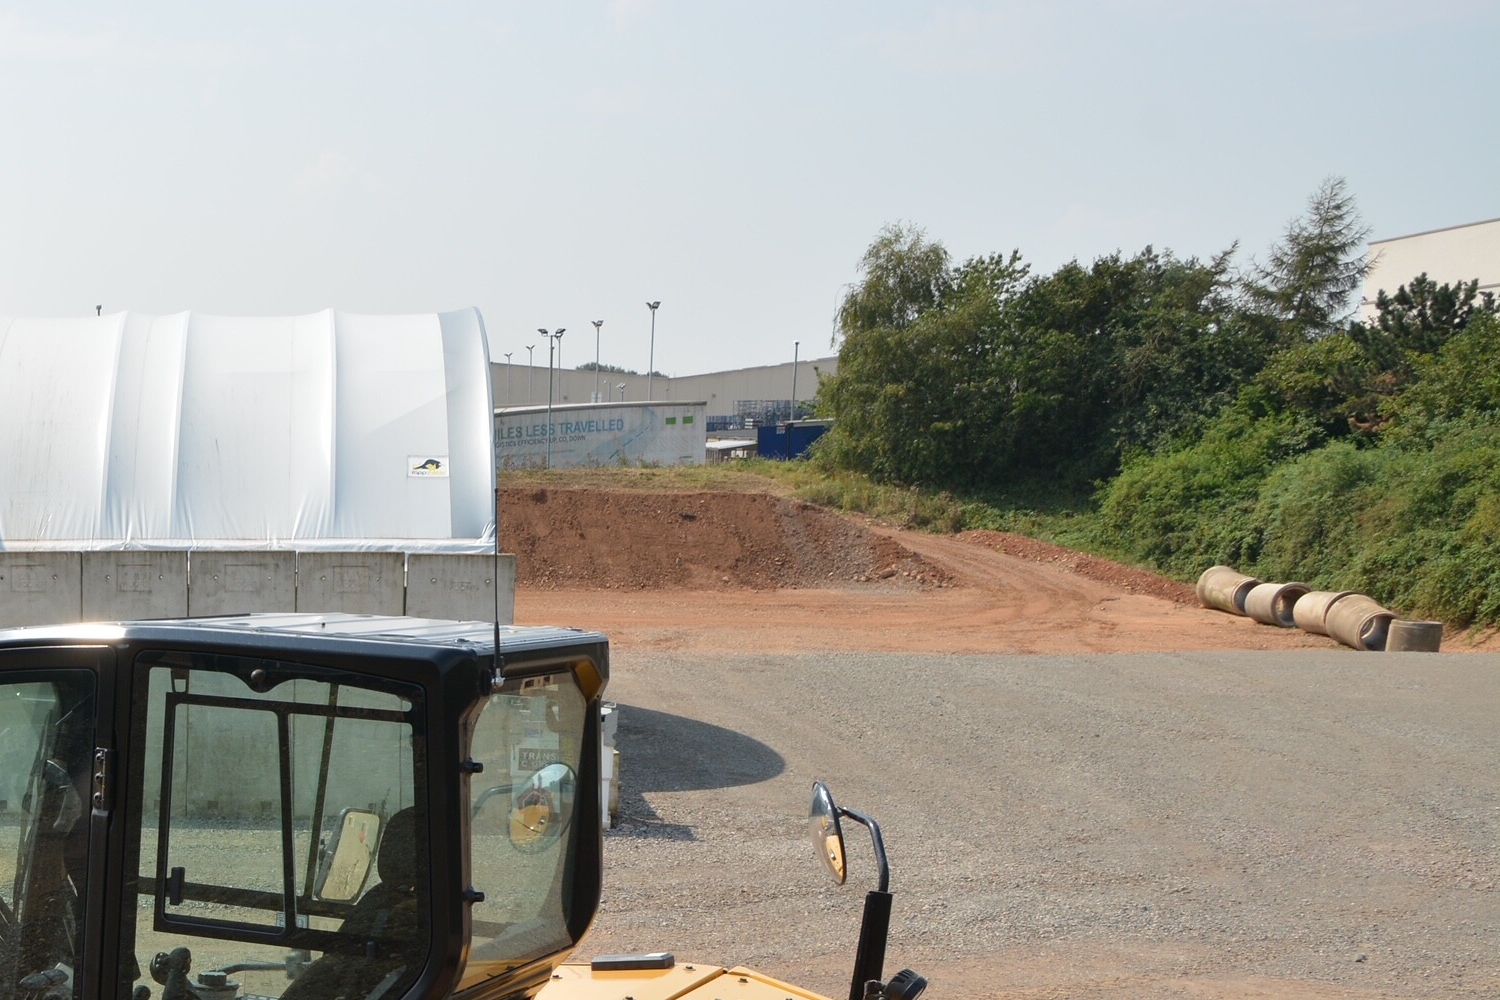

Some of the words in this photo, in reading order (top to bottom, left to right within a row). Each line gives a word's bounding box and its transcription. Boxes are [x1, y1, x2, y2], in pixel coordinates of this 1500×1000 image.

[494, 426, 523, 440] ILES
[526, 423, 555, 438] LESS
[558, 418, 624, 435] TRAVELLED
[522, 751, 557, 760] TRANS
